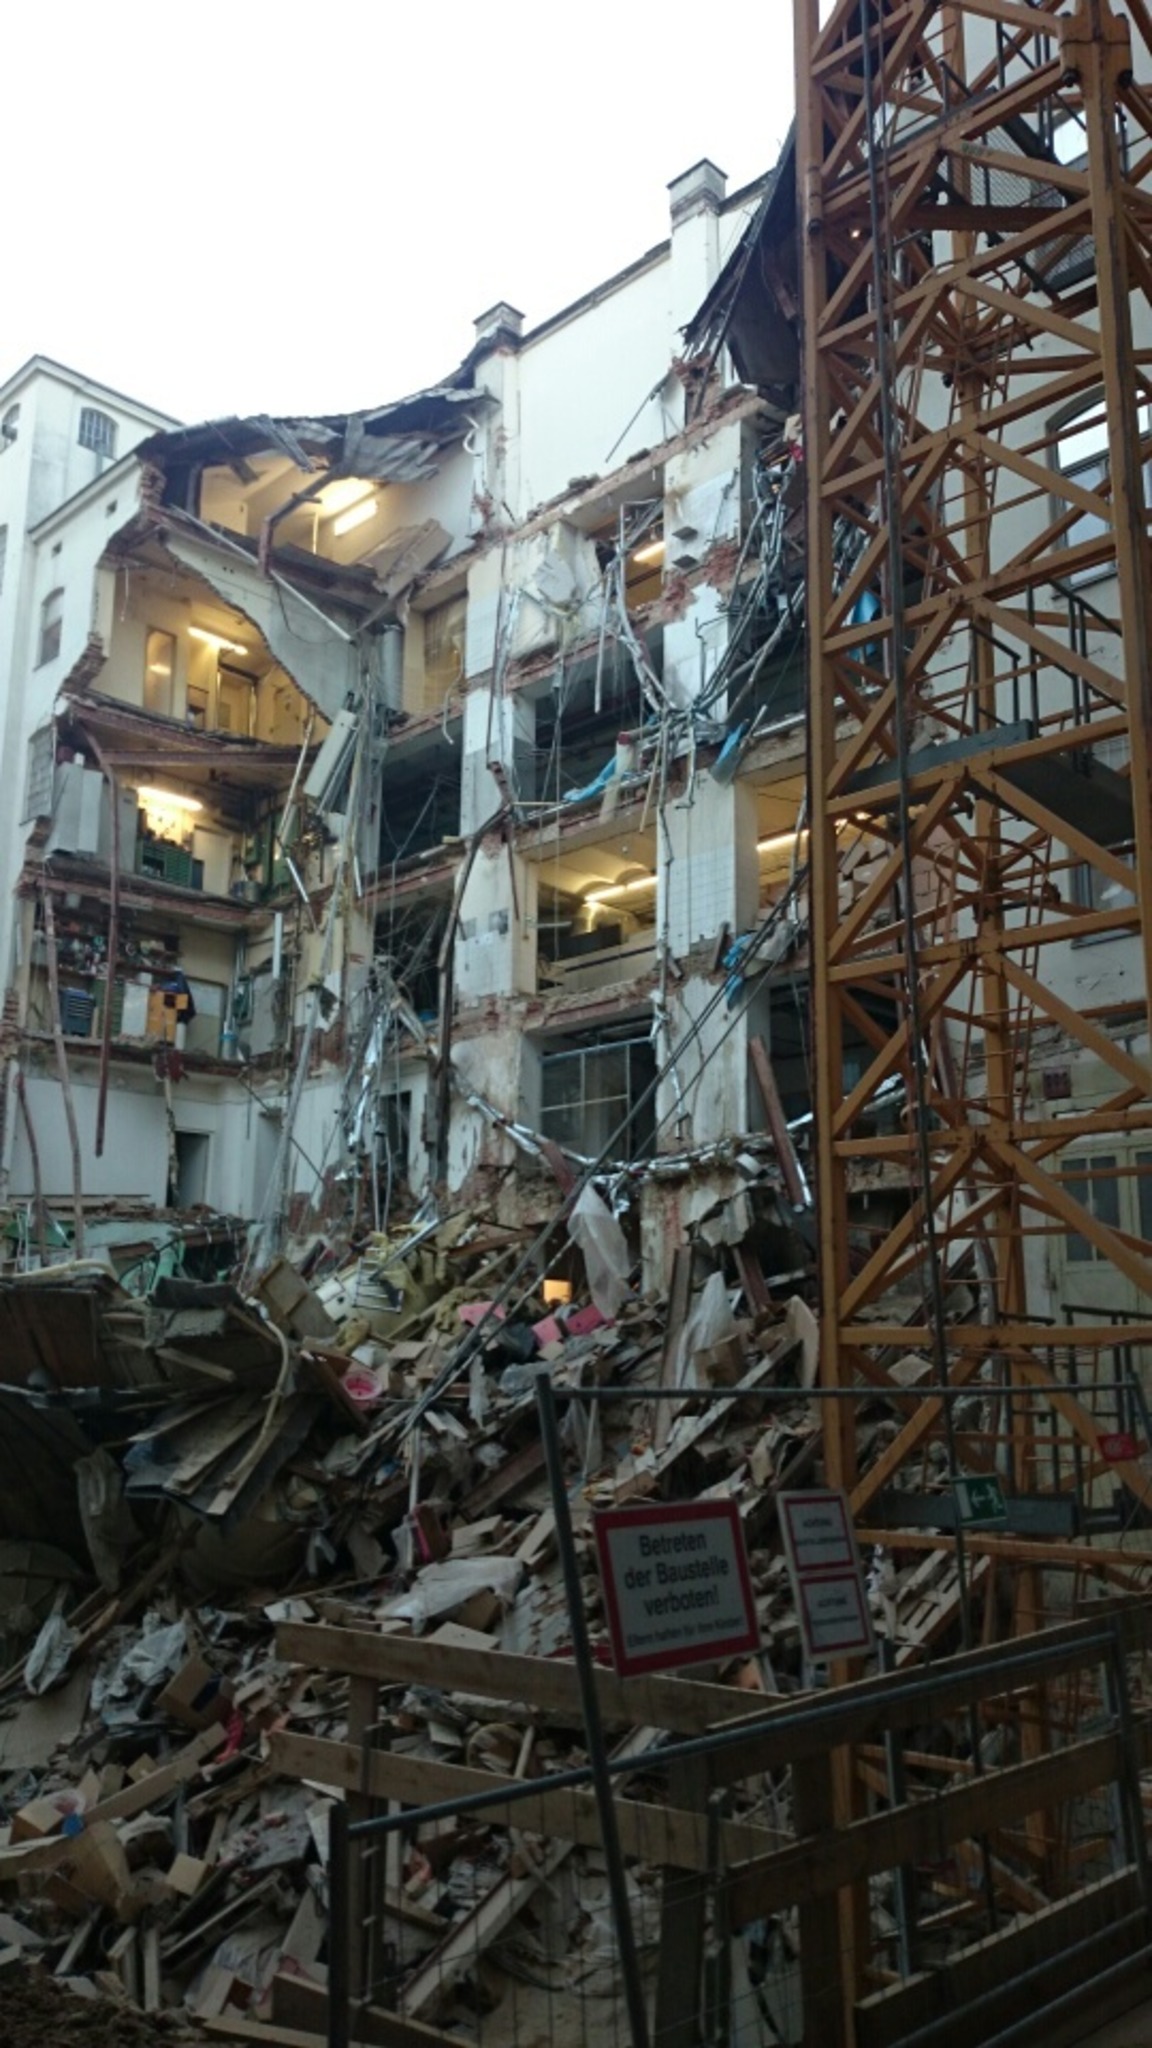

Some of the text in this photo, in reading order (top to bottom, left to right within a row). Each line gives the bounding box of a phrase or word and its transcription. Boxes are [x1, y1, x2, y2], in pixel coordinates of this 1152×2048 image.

[639, 1531, 707, 1557] Betreten
[624, 1554, 729, 1590] der Baustelle
[643, 1583, 720, 1616] verboten!
